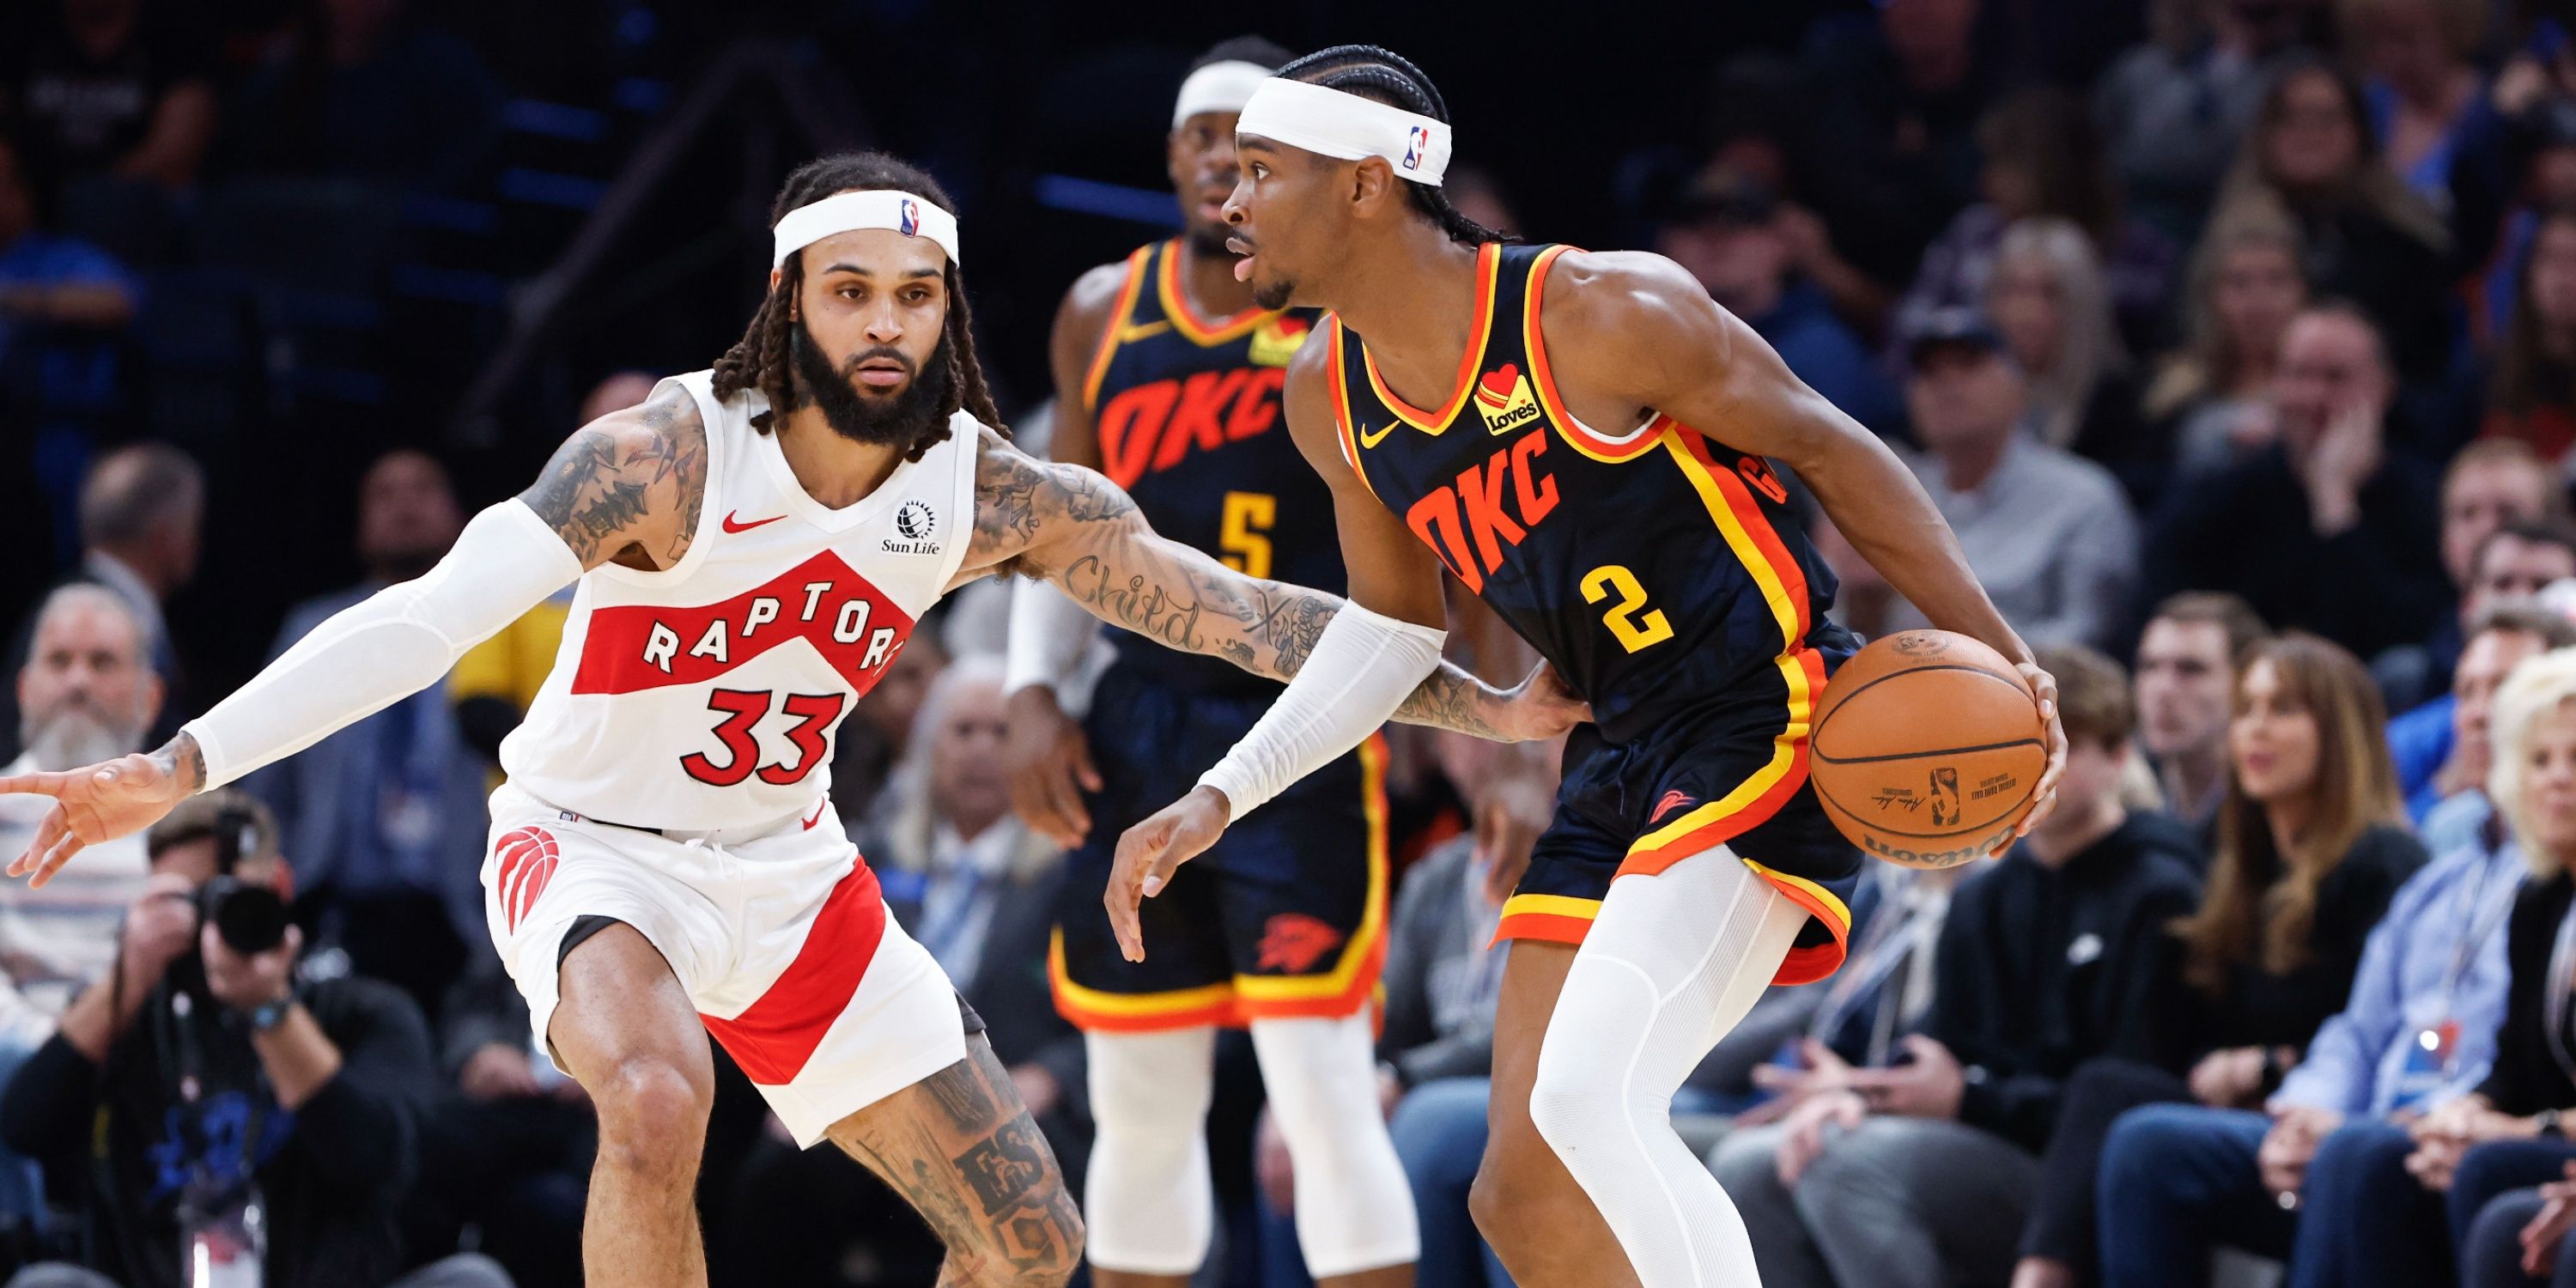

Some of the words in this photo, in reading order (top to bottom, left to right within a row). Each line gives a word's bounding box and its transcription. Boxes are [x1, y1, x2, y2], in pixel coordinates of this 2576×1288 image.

[1099, 367, 1287, 491] OKC
[882, 539, 910, 553] Sun
[914, 543, 939, 555] Life
[1220, 490, 1276, 580] 5
[1406, 427, 1560, 596] OKC
[1065, 556, 1203, 650] Child
[1579, 565, 1674, 654] 2
[680, 689, 846, 787] 33
